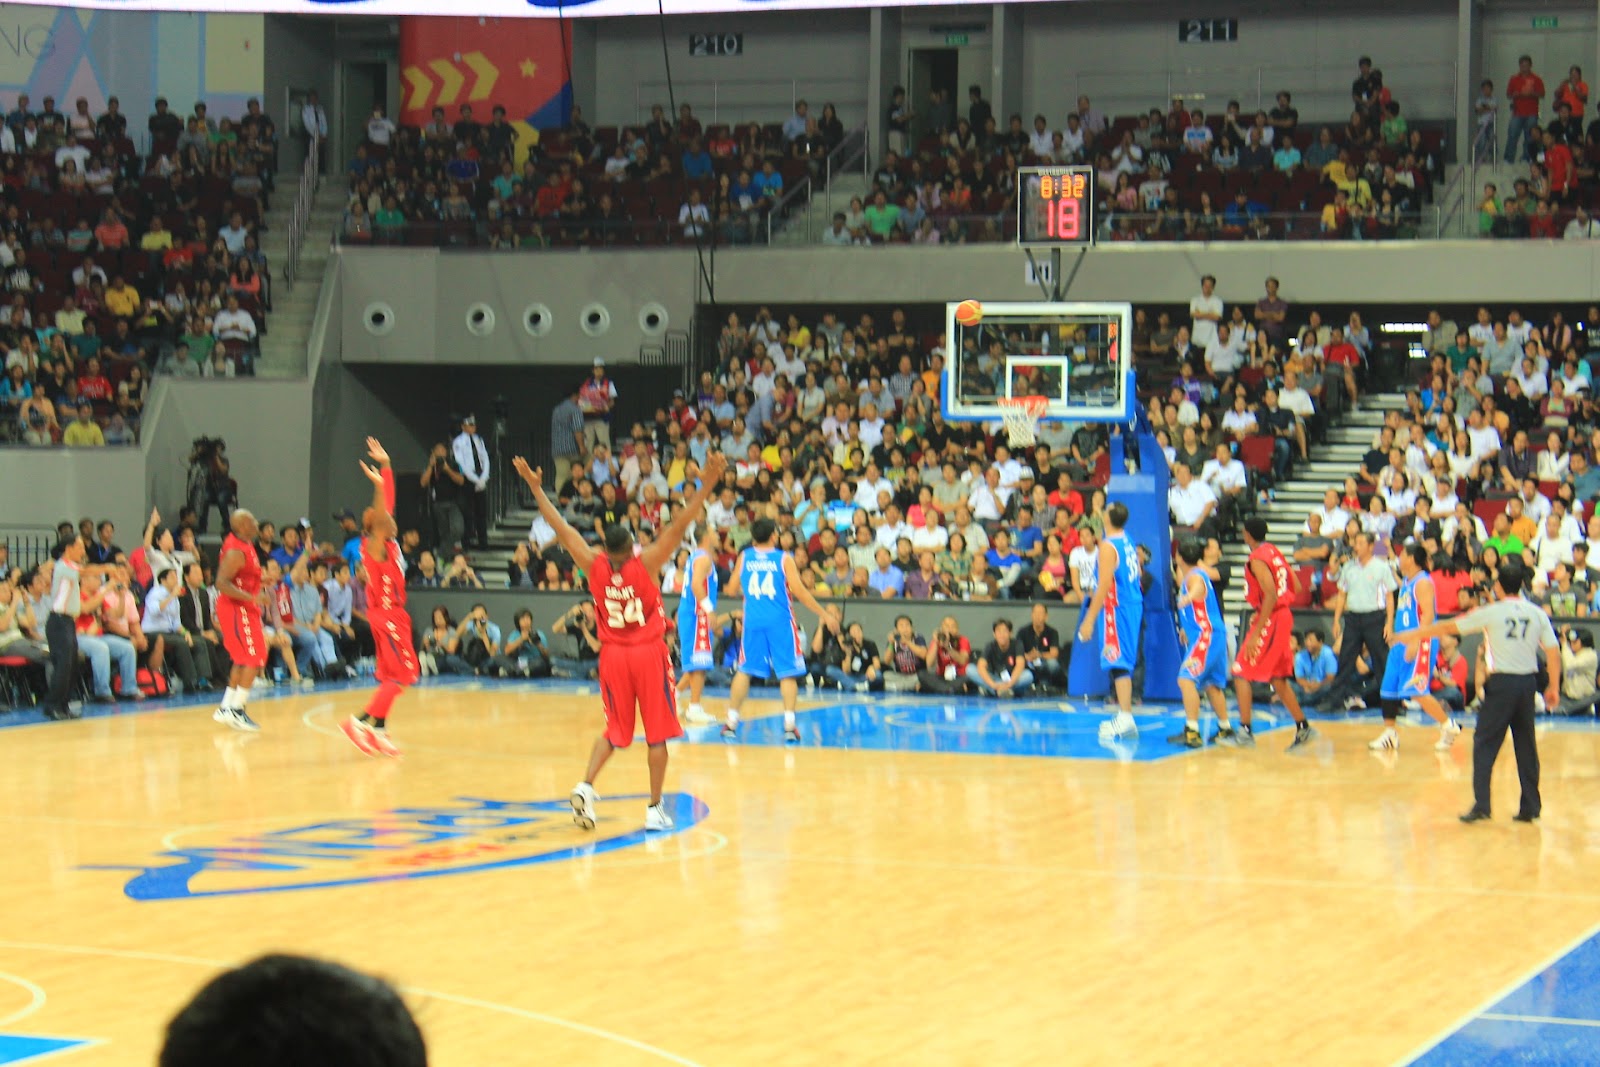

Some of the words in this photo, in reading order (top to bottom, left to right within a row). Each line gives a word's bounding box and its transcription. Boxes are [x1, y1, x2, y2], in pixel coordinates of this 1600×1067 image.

[1187, 19, 1230, 41] 211
[694, 34, 738, 56] 210
[1041, 174, 1085, 199] 8:32
[1047, 198, 1079, 239] 18
[748, 570, 777, 600] 44
[604, 597, 646, 629] 54
[1504, 616, 1530, 640] 27
